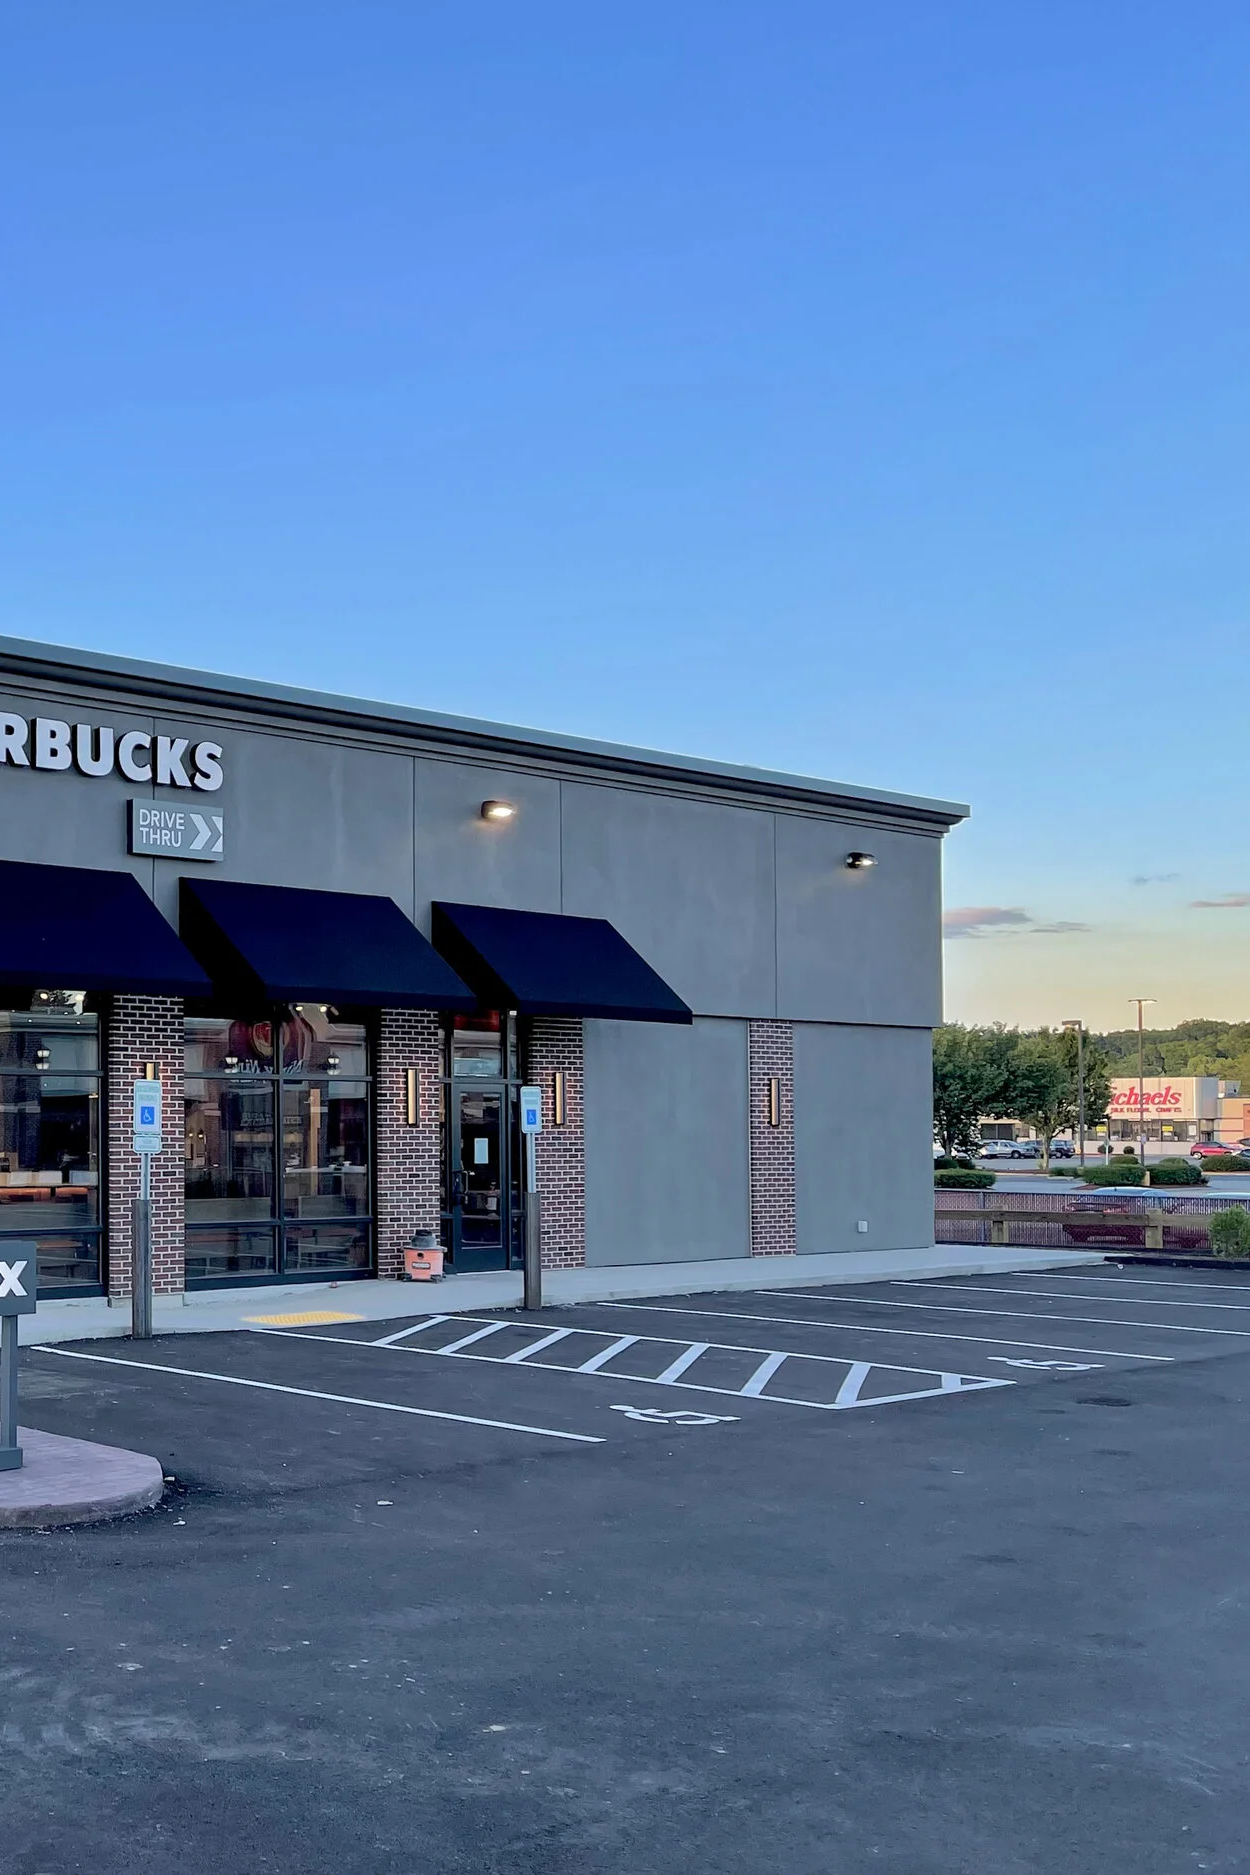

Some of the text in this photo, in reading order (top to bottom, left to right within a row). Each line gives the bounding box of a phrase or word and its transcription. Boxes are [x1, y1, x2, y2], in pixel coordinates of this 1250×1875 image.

[139, 808, 185, 830] DRIVE
[139, 827, 182, 848] THRU
[1110, 1086, 1182, 1106] ichaels
